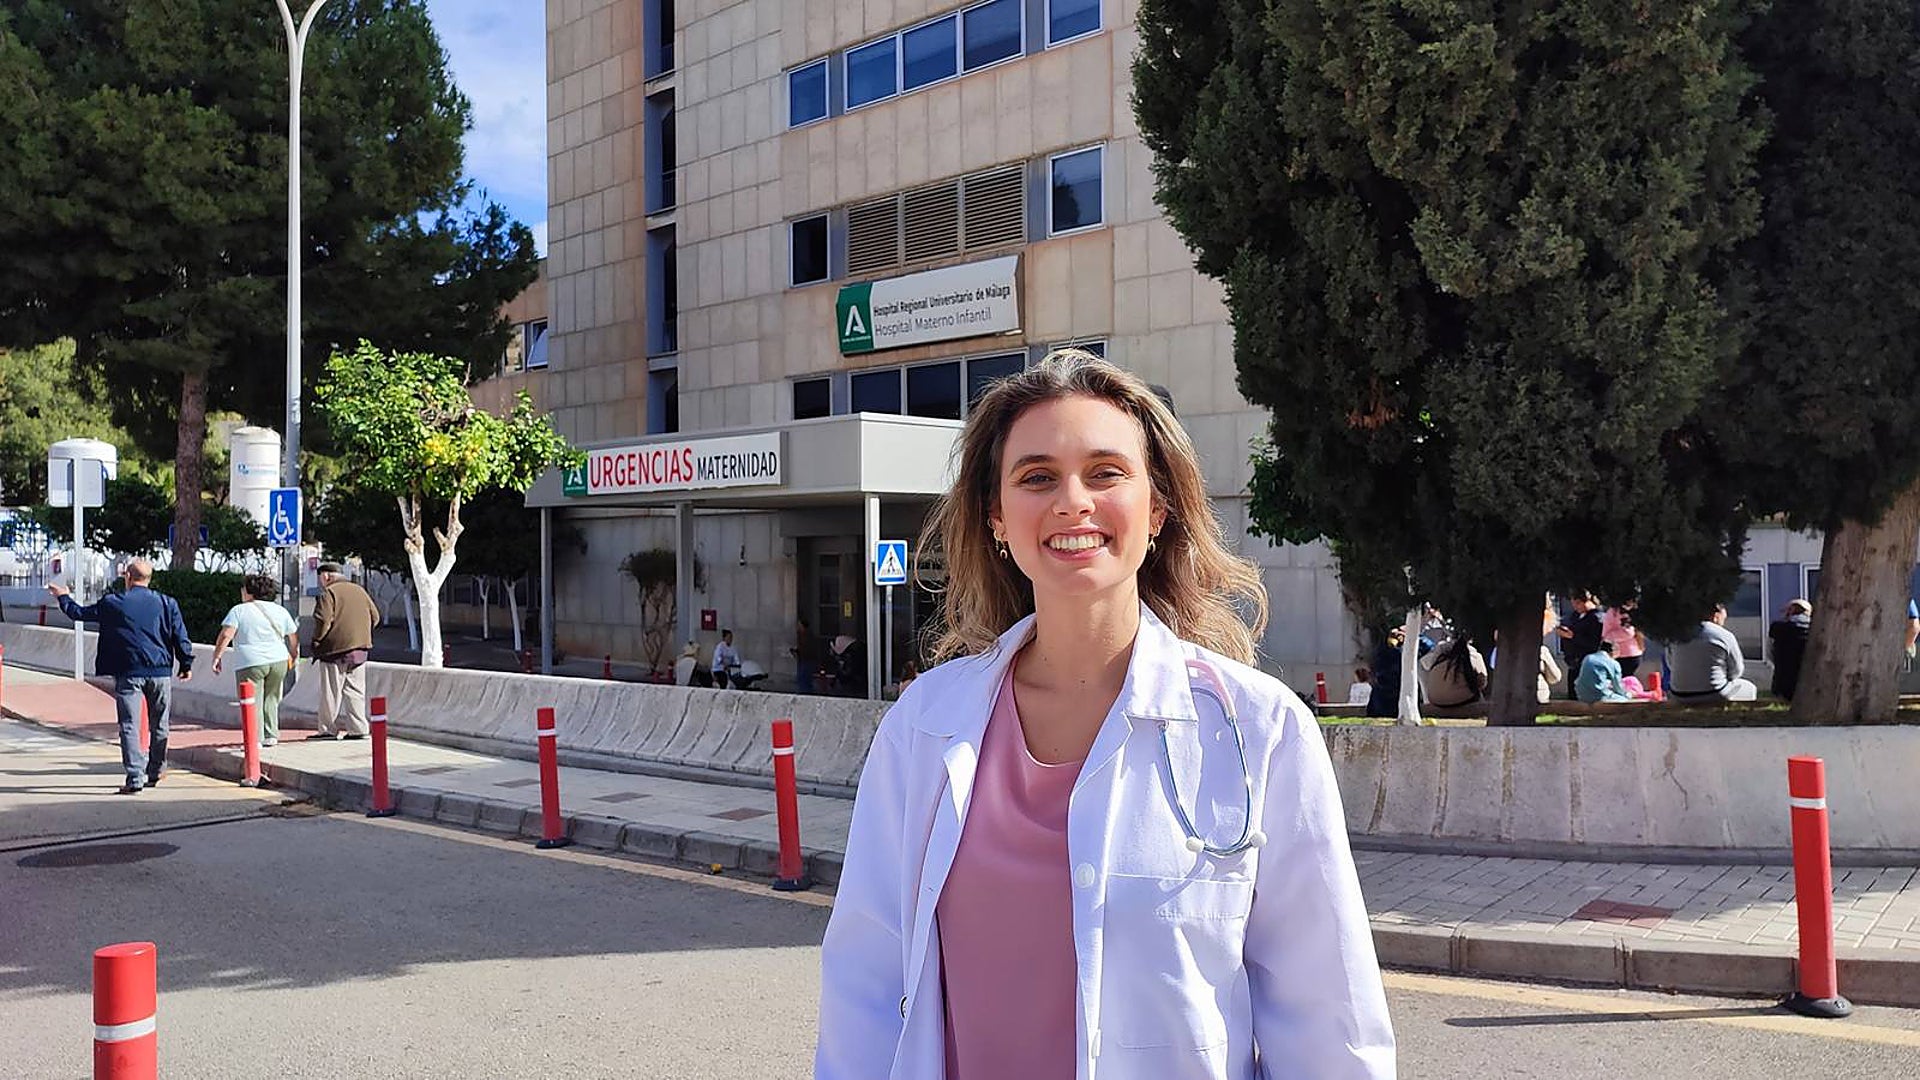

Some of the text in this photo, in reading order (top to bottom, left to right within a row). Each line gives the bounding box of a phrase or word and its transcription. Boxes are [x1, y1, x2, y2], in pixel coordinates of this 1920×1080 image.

[873, 283, 1010, 317] Hospital Regional Universitario de Málaga
[875, 306, 992, 338] Hospital Materno Infantil
[590, 447, 777, 488] URGENCIAS MATERNIDAD
